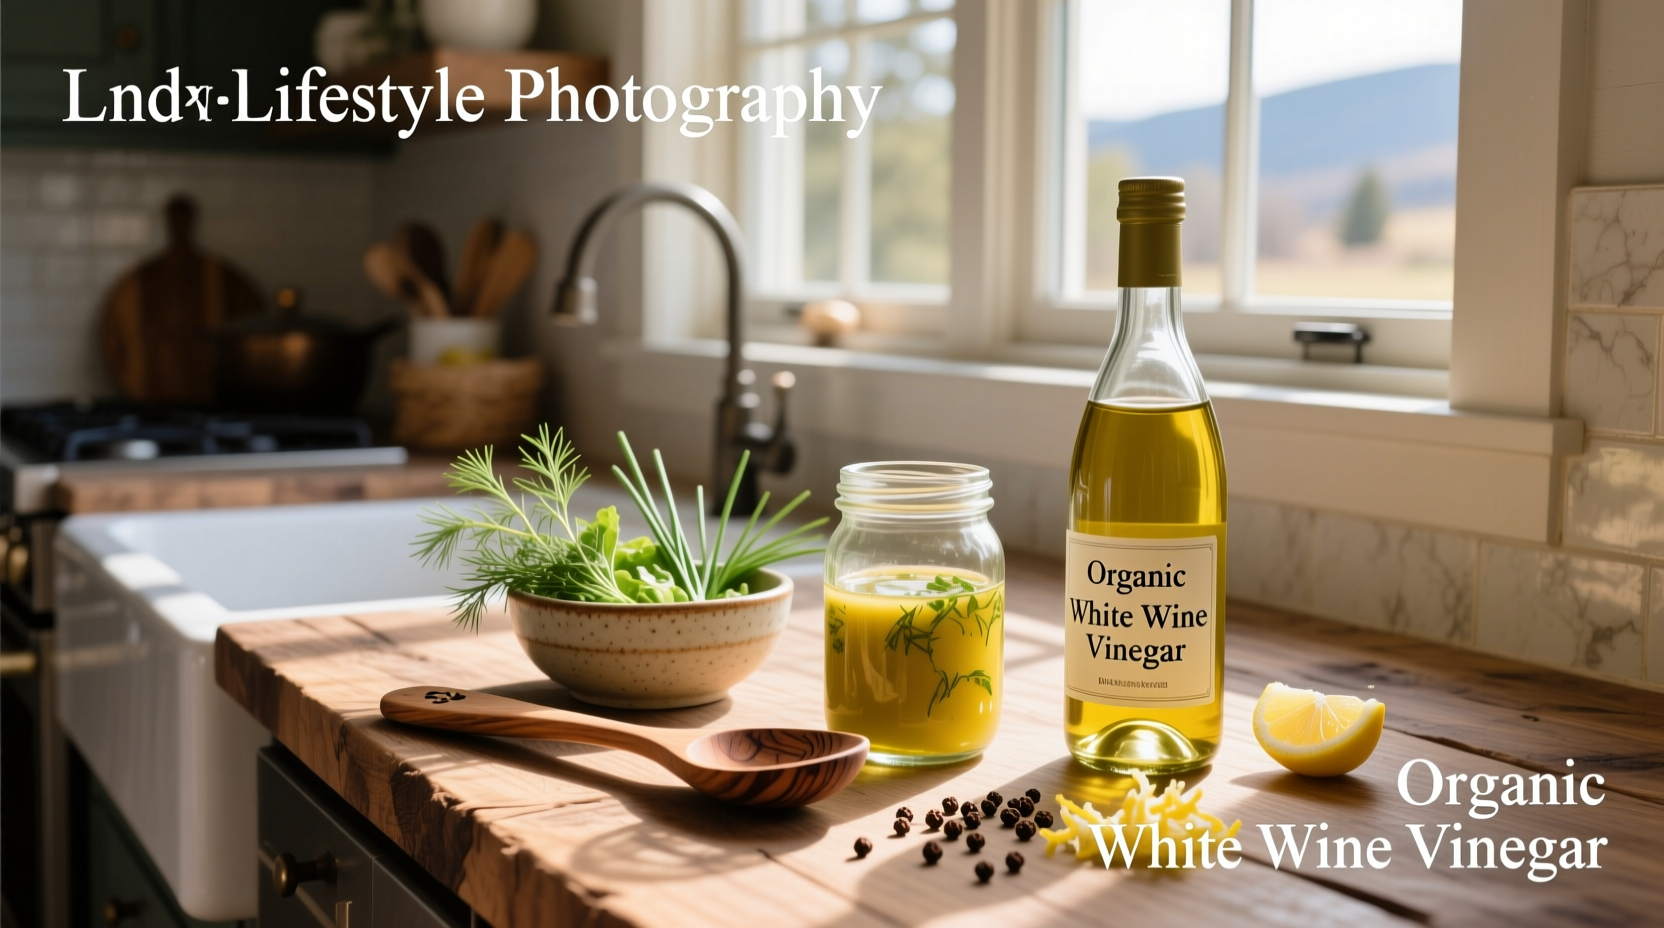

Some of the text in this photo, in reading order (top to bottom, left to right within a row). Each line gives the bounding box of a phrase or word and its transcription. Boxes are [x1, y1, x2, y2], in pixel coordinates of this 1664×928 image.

[1087, 560, 1186, 595] Organic
[1070, 597, 1208, 629] White Wine
[1086, 633, 1187, 670] Vinegar
